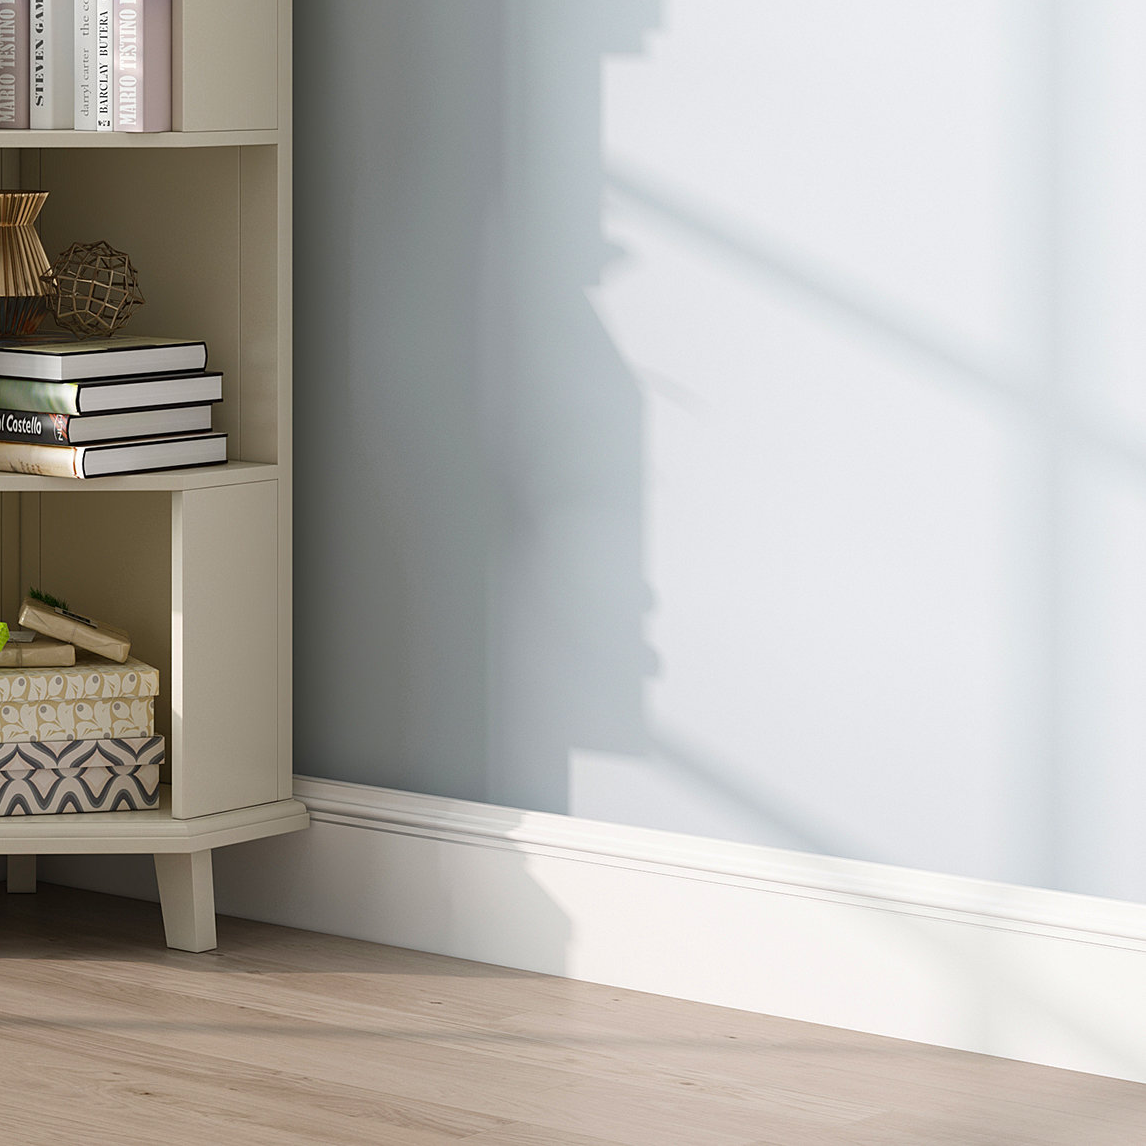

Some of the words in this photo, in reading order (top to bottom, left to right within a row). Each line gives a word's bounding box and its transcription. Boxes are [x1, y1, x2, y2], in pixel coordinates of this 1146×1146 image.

[0, 9, 15, 69] TESTINO
[80, 16, 89, 36] the
[99, 11, 108, 56] BUTERA
[119, 9, 137, 71] TESTINO
[0, 73, 15, 122] MARIO
[35, 39, 44, 107] STEVEN
[99, 63, 108, 114] BARCLAY
[81, 84, 92, 117] darryl
[119, 75, 137, 124] MARIO
[6, 414, 42, 434] Costello
